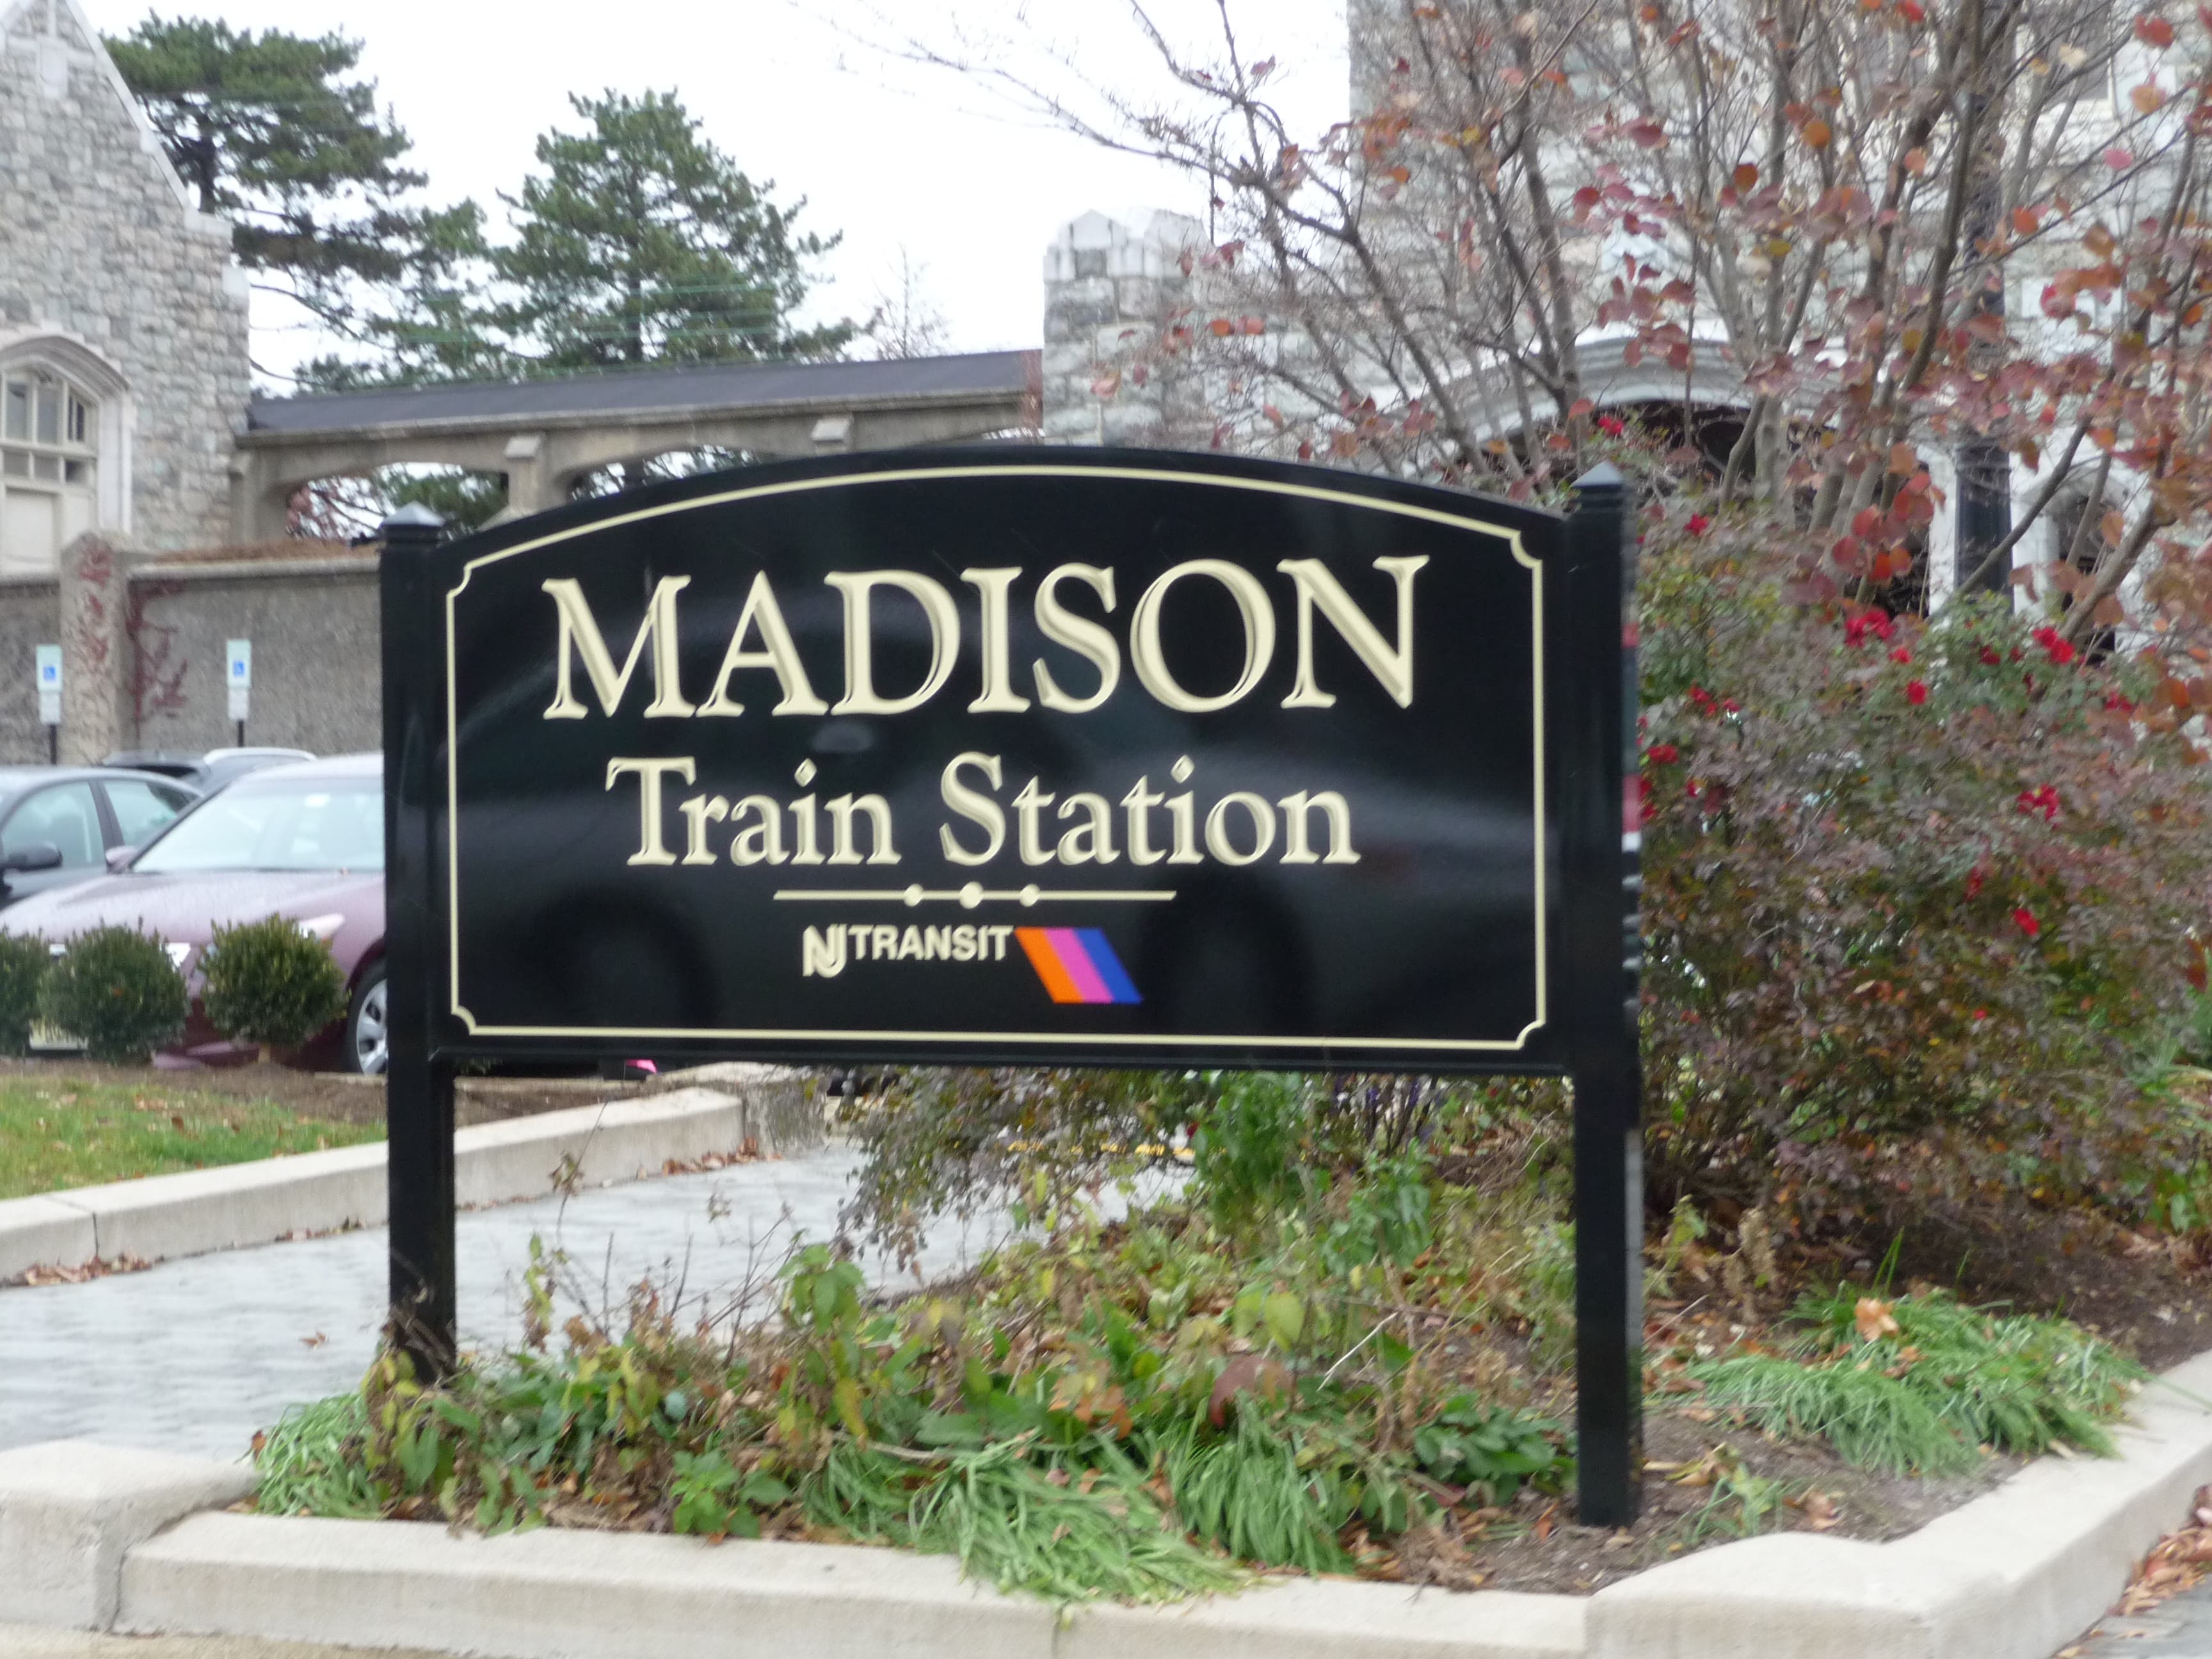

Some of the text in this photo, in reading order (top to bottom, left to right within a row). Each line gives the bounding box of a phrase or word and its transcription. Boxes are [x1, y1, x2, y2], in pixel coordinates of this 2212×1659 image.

[541, 555, 1430, 720] MADISON
[605, 751, 1361, 867] Train Station
[802, 924, 1014, 978] NJ TRANSIT
